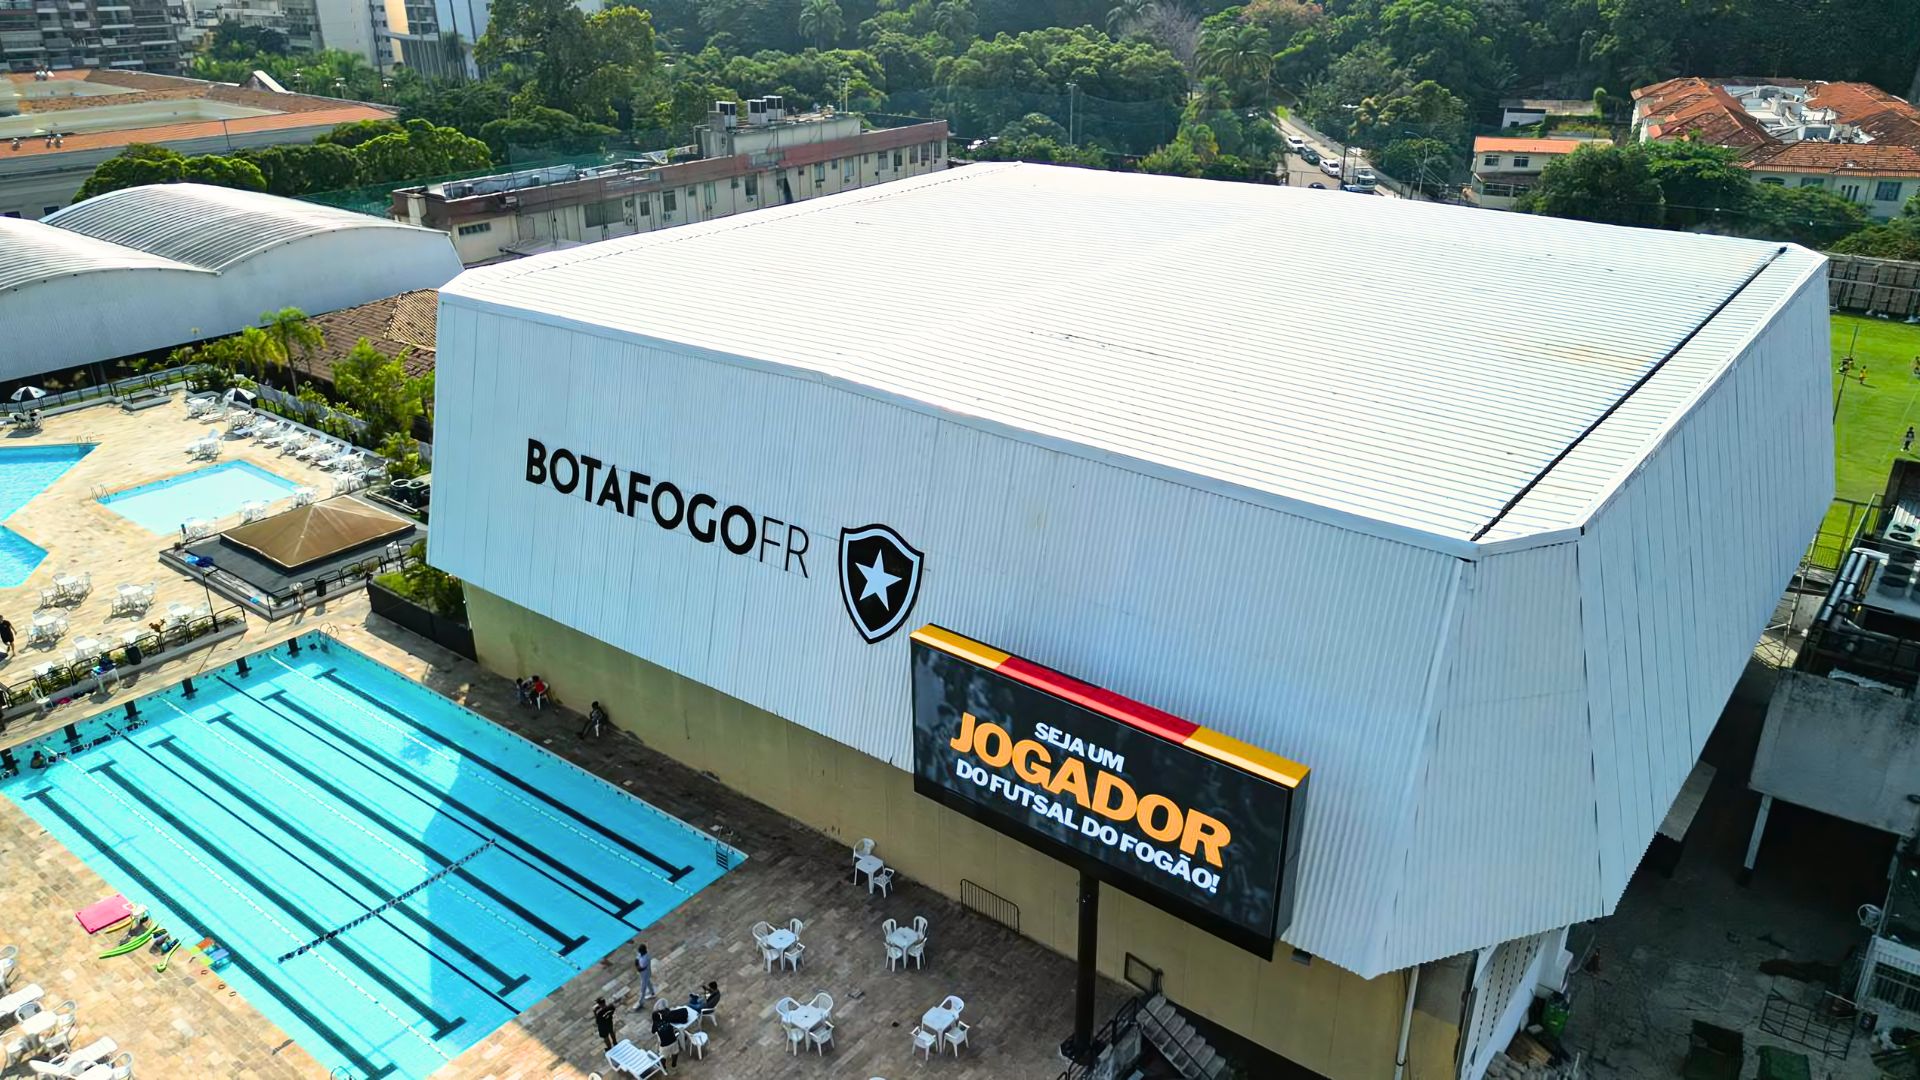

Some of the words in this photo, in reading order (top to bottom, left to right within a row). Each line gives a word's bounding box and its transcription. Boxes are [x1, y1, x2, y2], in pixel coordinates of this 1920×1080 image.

[950, 712, 1231, 868] JOGADOR
[1034, 722, 1085, 757] SEJA
[1087, 746, 1125, 773] UM
[956, 758, 989, 787] DO
[989, 773, 1079, 831] FUTSAL
[1080, 816, 1119, 846] DO
[1119, 833, 1221, 894] FOGÃO!
